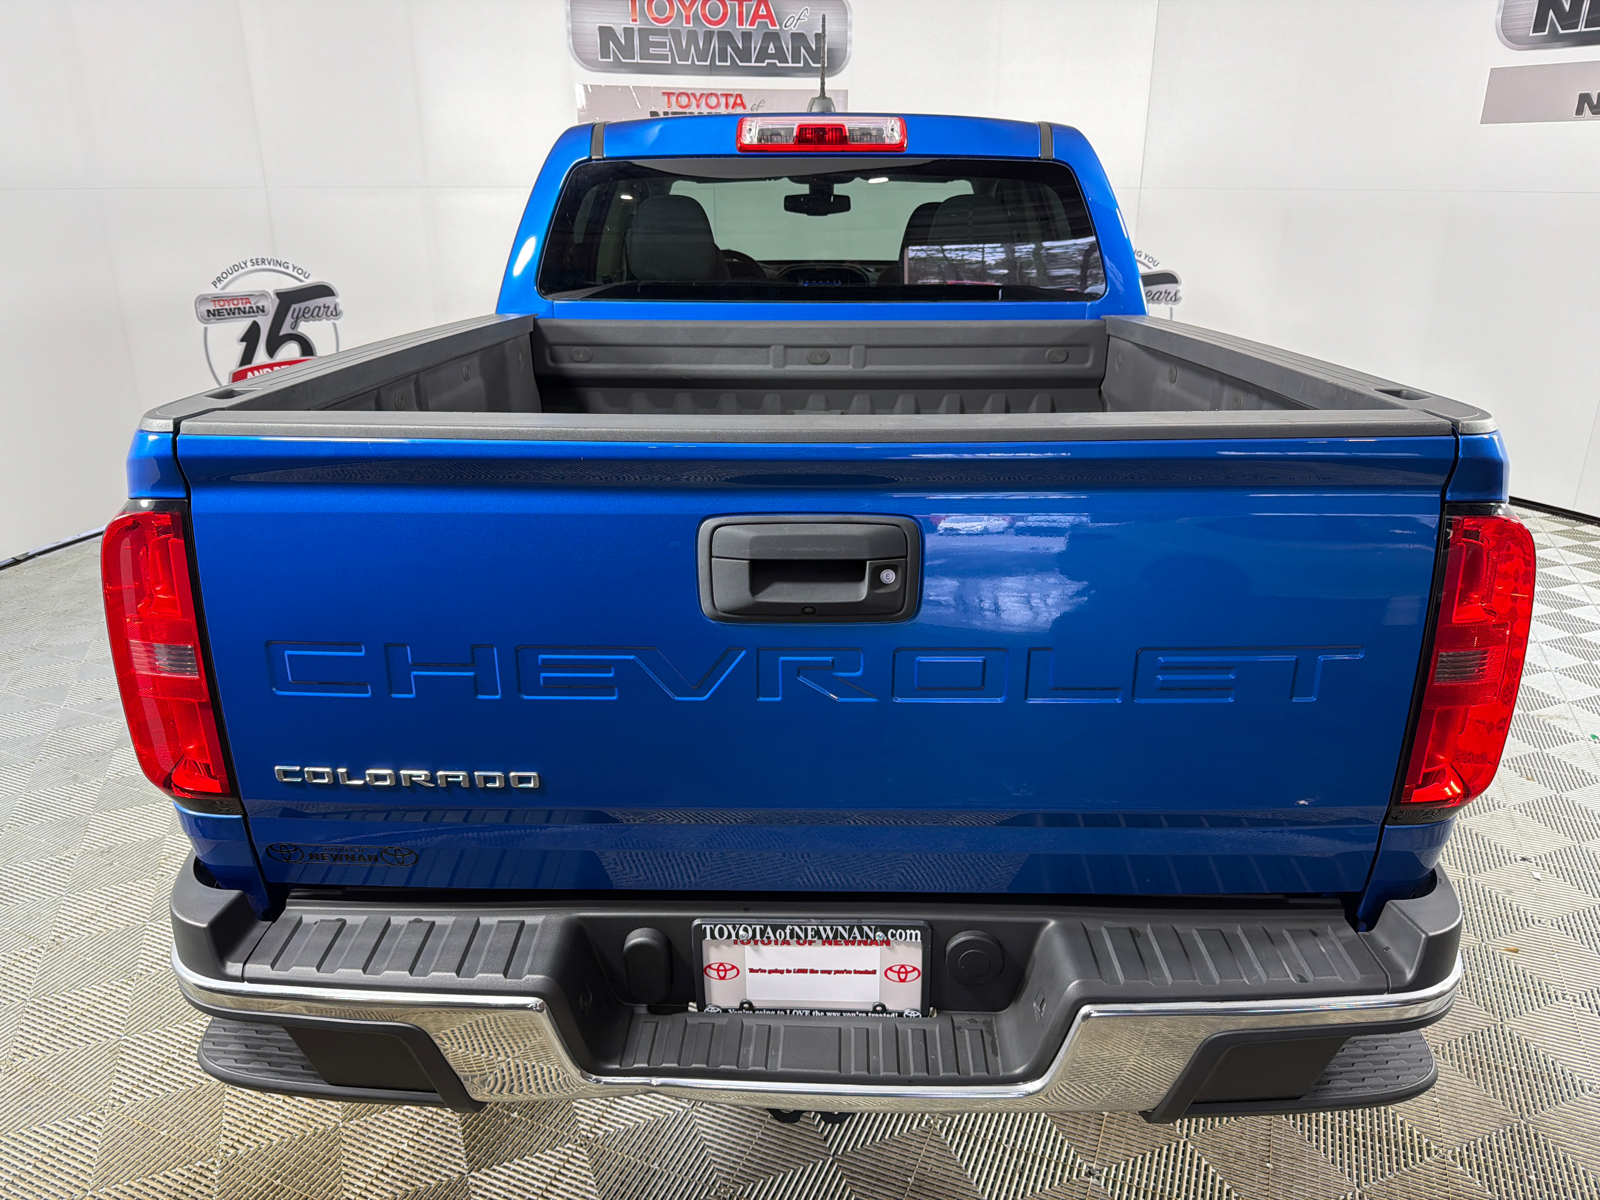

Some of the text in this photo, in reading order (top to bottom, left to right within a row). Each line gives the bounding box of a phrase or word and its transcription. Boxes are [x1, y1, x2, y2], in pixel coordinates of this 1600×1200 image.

[628, 0, 809, 30] TOYOTA of
[597, 25, 827, 66] NEWNAN
[661, 91, 747, 111] TOYOTA
[211, 257, 311, 289] PROUDLY SERVING YOU
[206, 305, 265, 318] NEWNAN
[210, 297, 252, 308] TOYOTA
[290, 302, 341, 331] years
[265, 640, 1366, 704] CHEVROLET
[274, 765, 541, 789] COLORADO
[308, 852, 379, 863] NEWNAN
